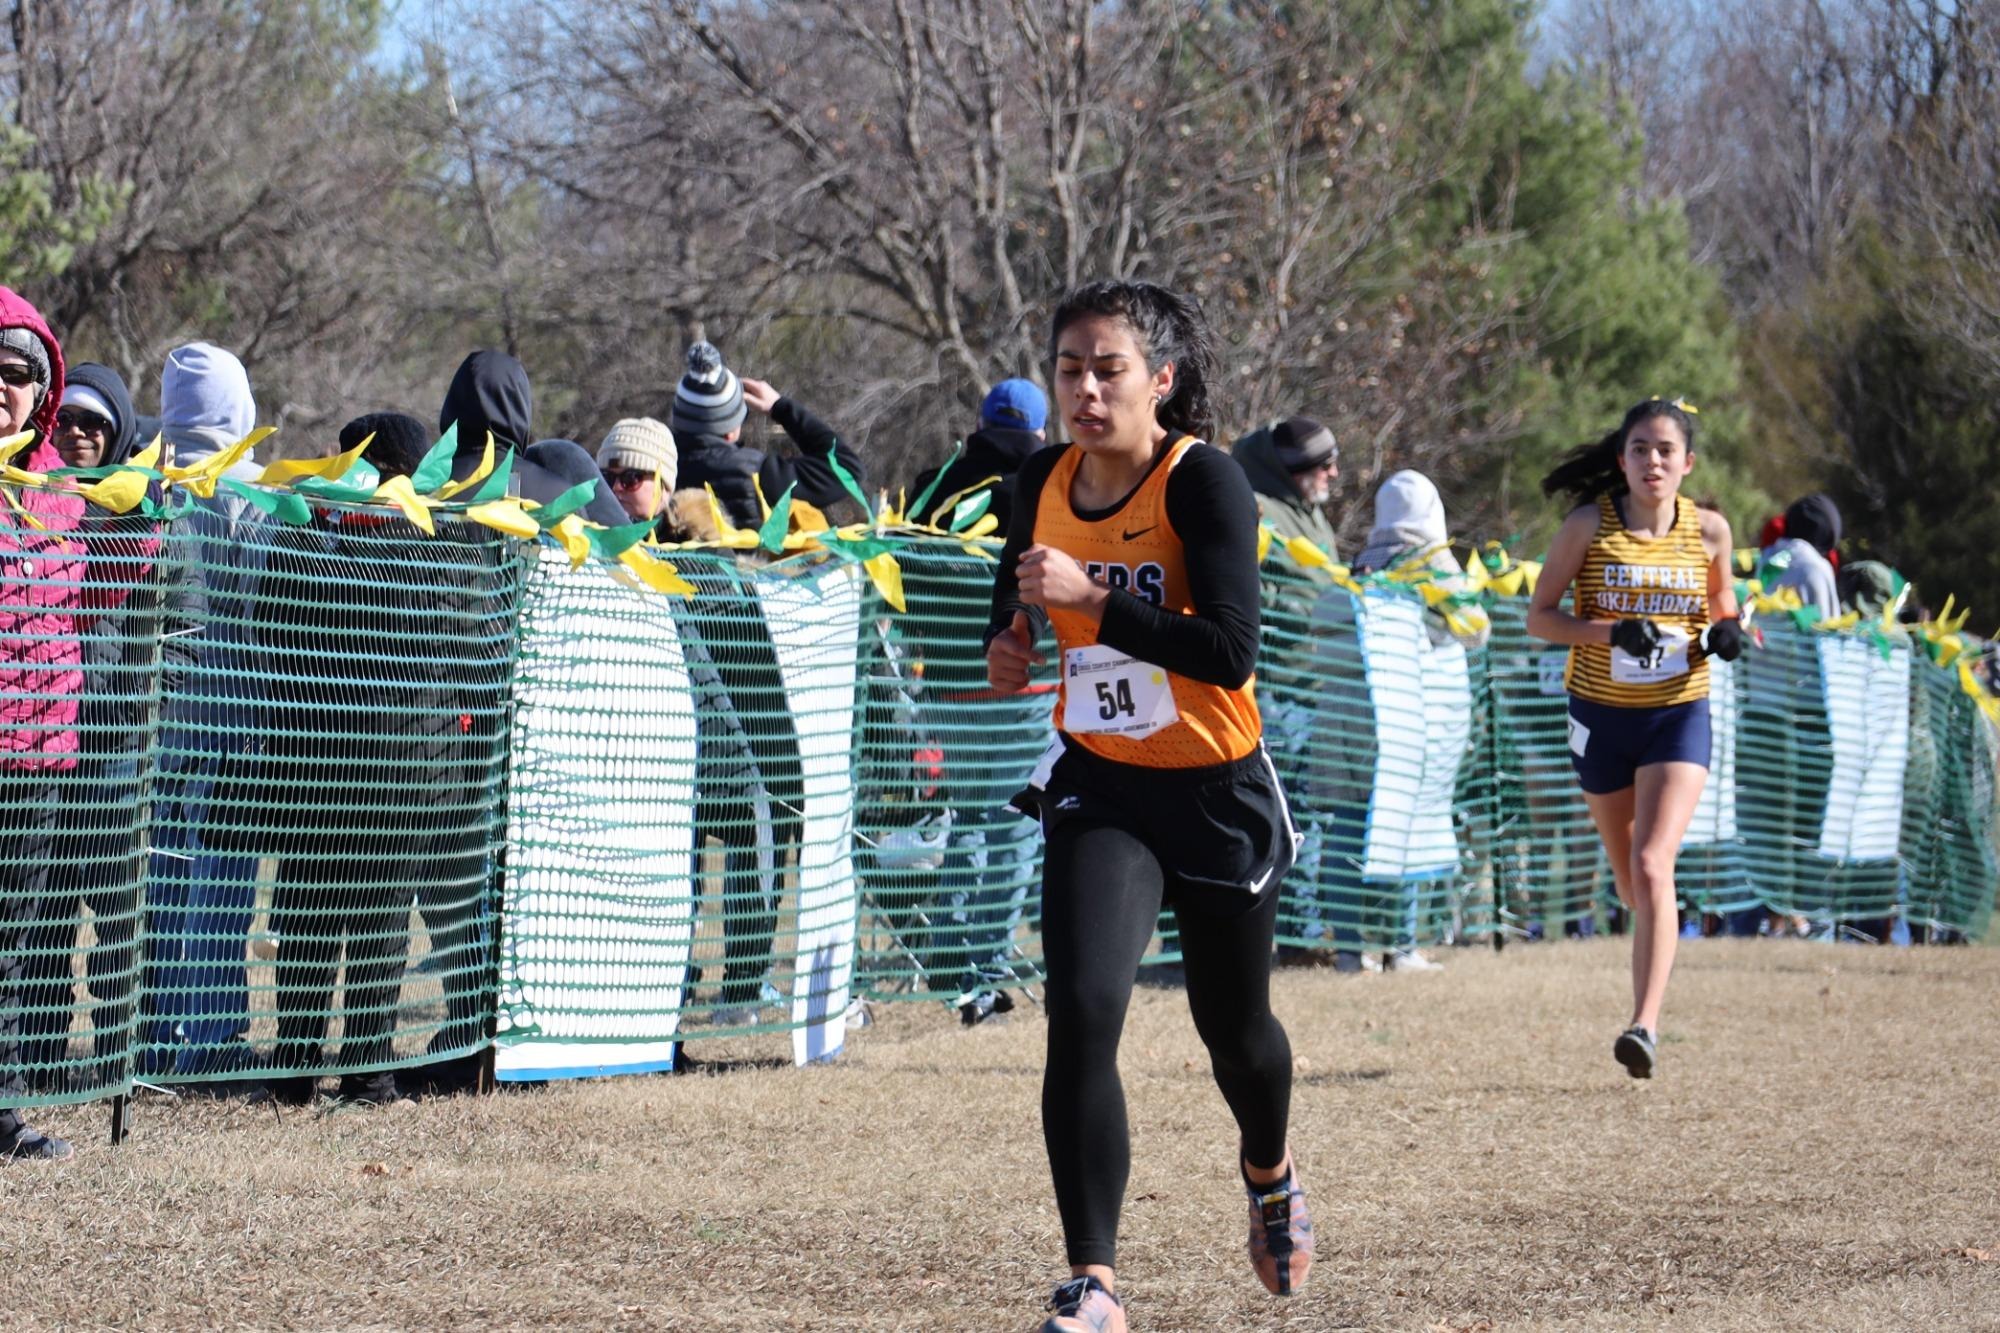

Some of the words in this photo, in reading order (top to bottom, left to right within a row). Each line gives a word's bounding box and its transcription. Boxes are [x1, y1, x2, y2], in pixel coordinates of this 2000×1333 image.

[1082, 560, 1165, 606] ERS
[1604, 564, 1699, 589] CENTRAL
[1597, 591, 1702, 615] OKLAHOMA
[1095, 678, 1136, 721] 54
